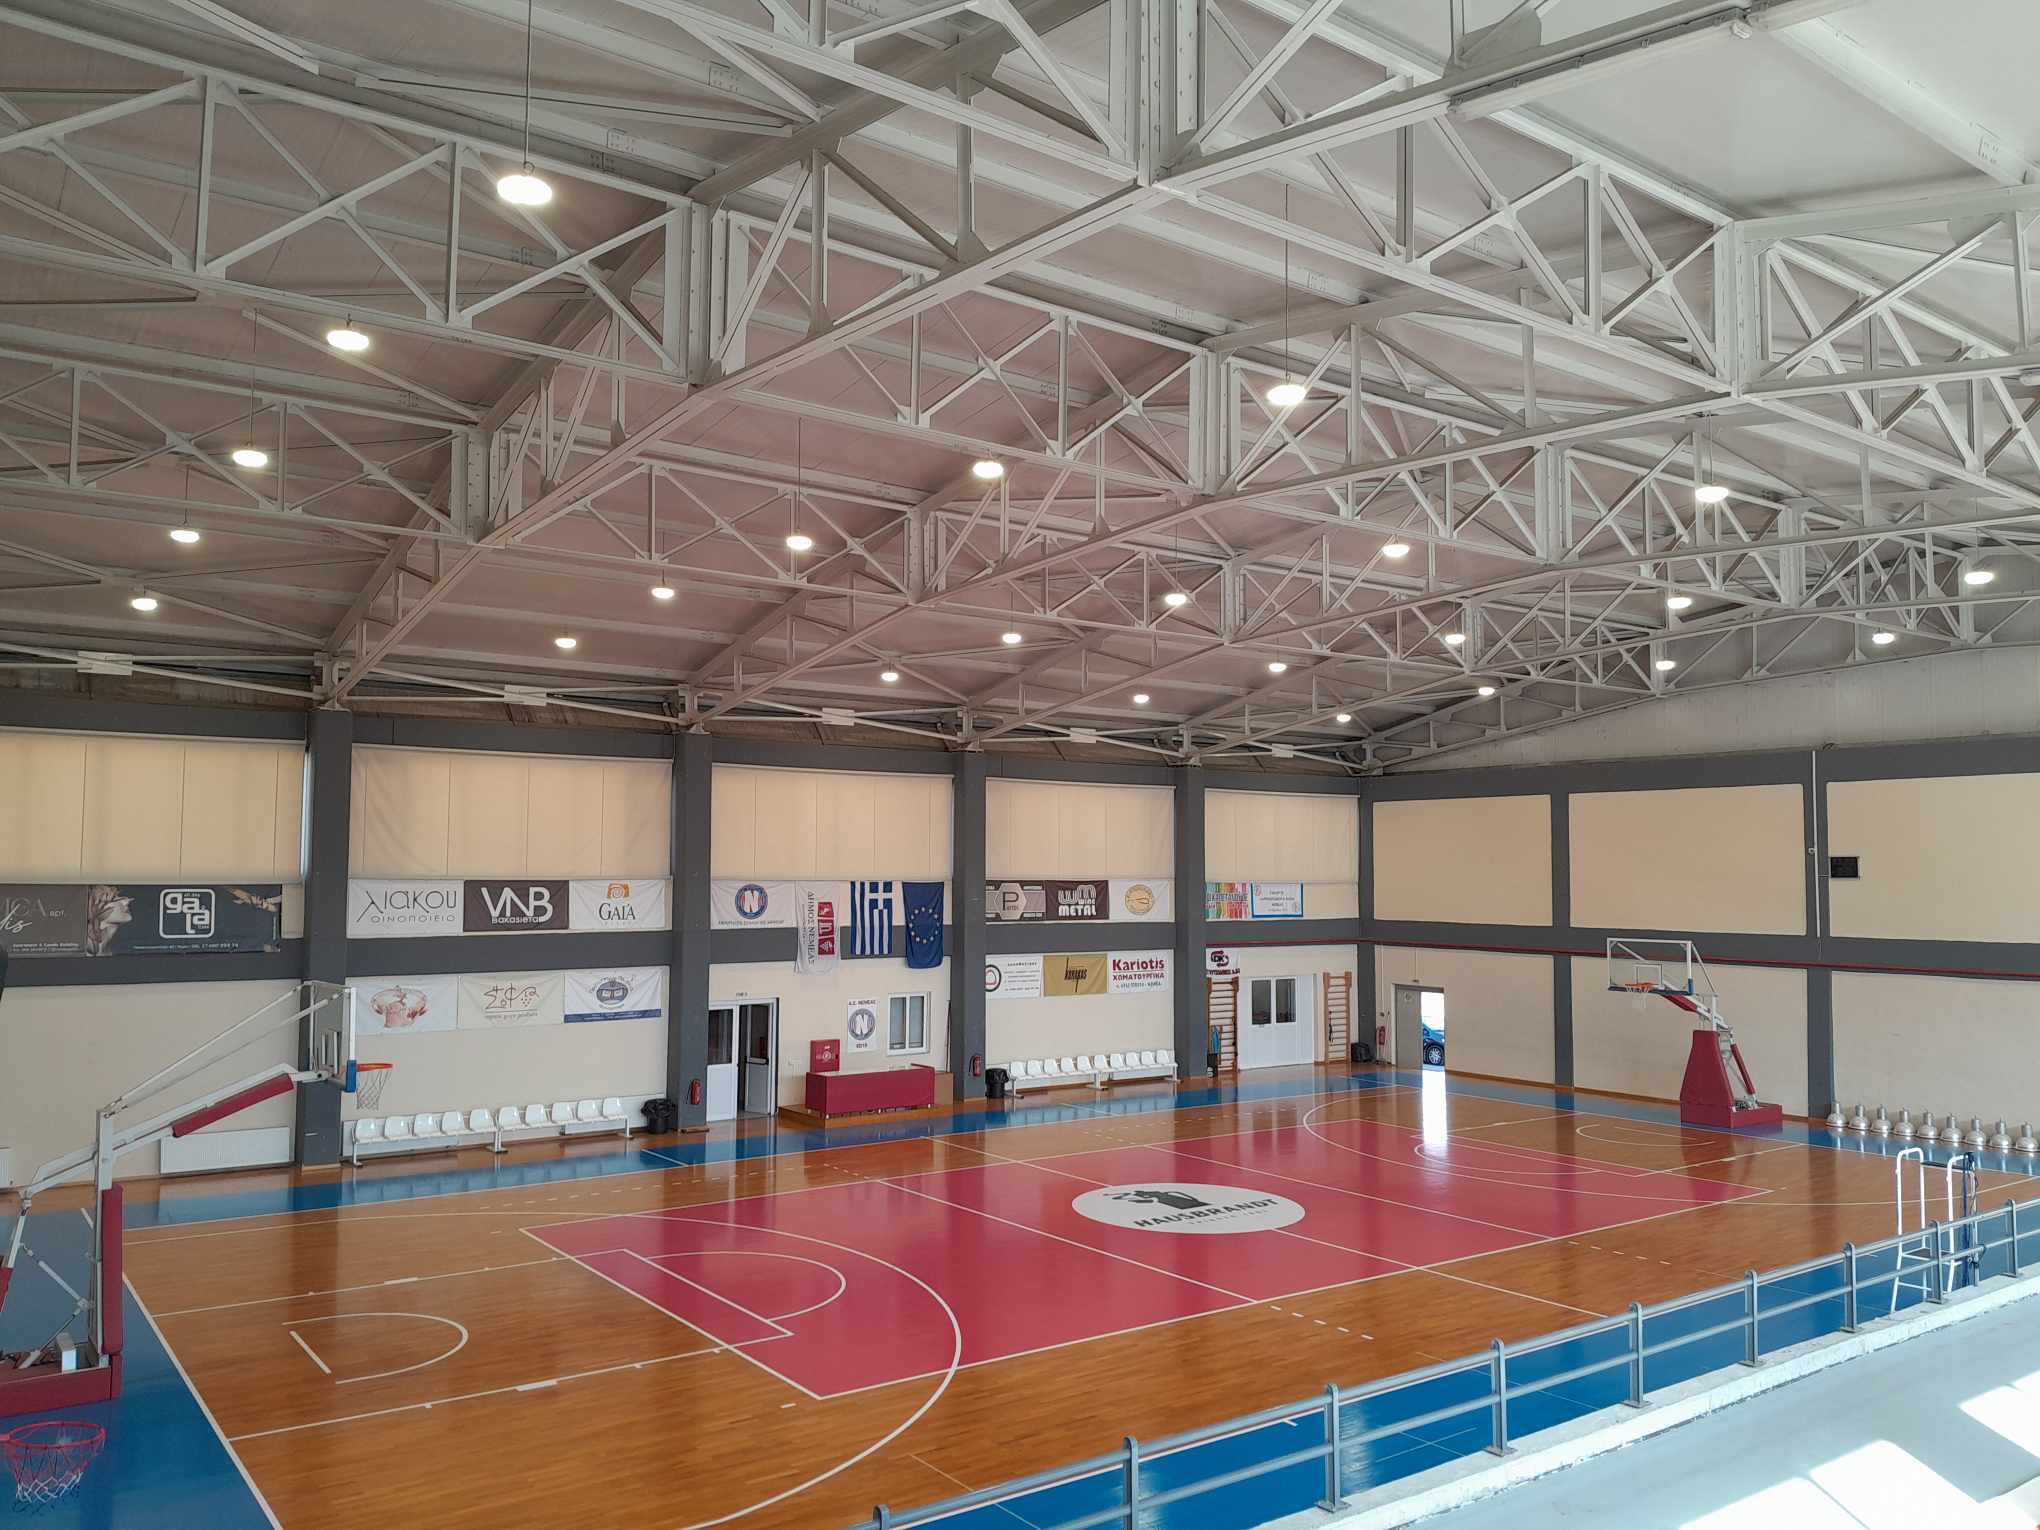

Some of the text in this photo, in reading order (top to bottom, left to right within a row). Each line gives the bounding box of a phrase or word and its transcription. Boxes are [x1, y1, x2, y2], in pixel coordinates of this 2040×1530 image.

[1058, 904, 1097, 917] METAL
[1112, 957, 1165, 971] Kariotis
[1133, 1198, 1279, 1227] HAUSBRANDT
